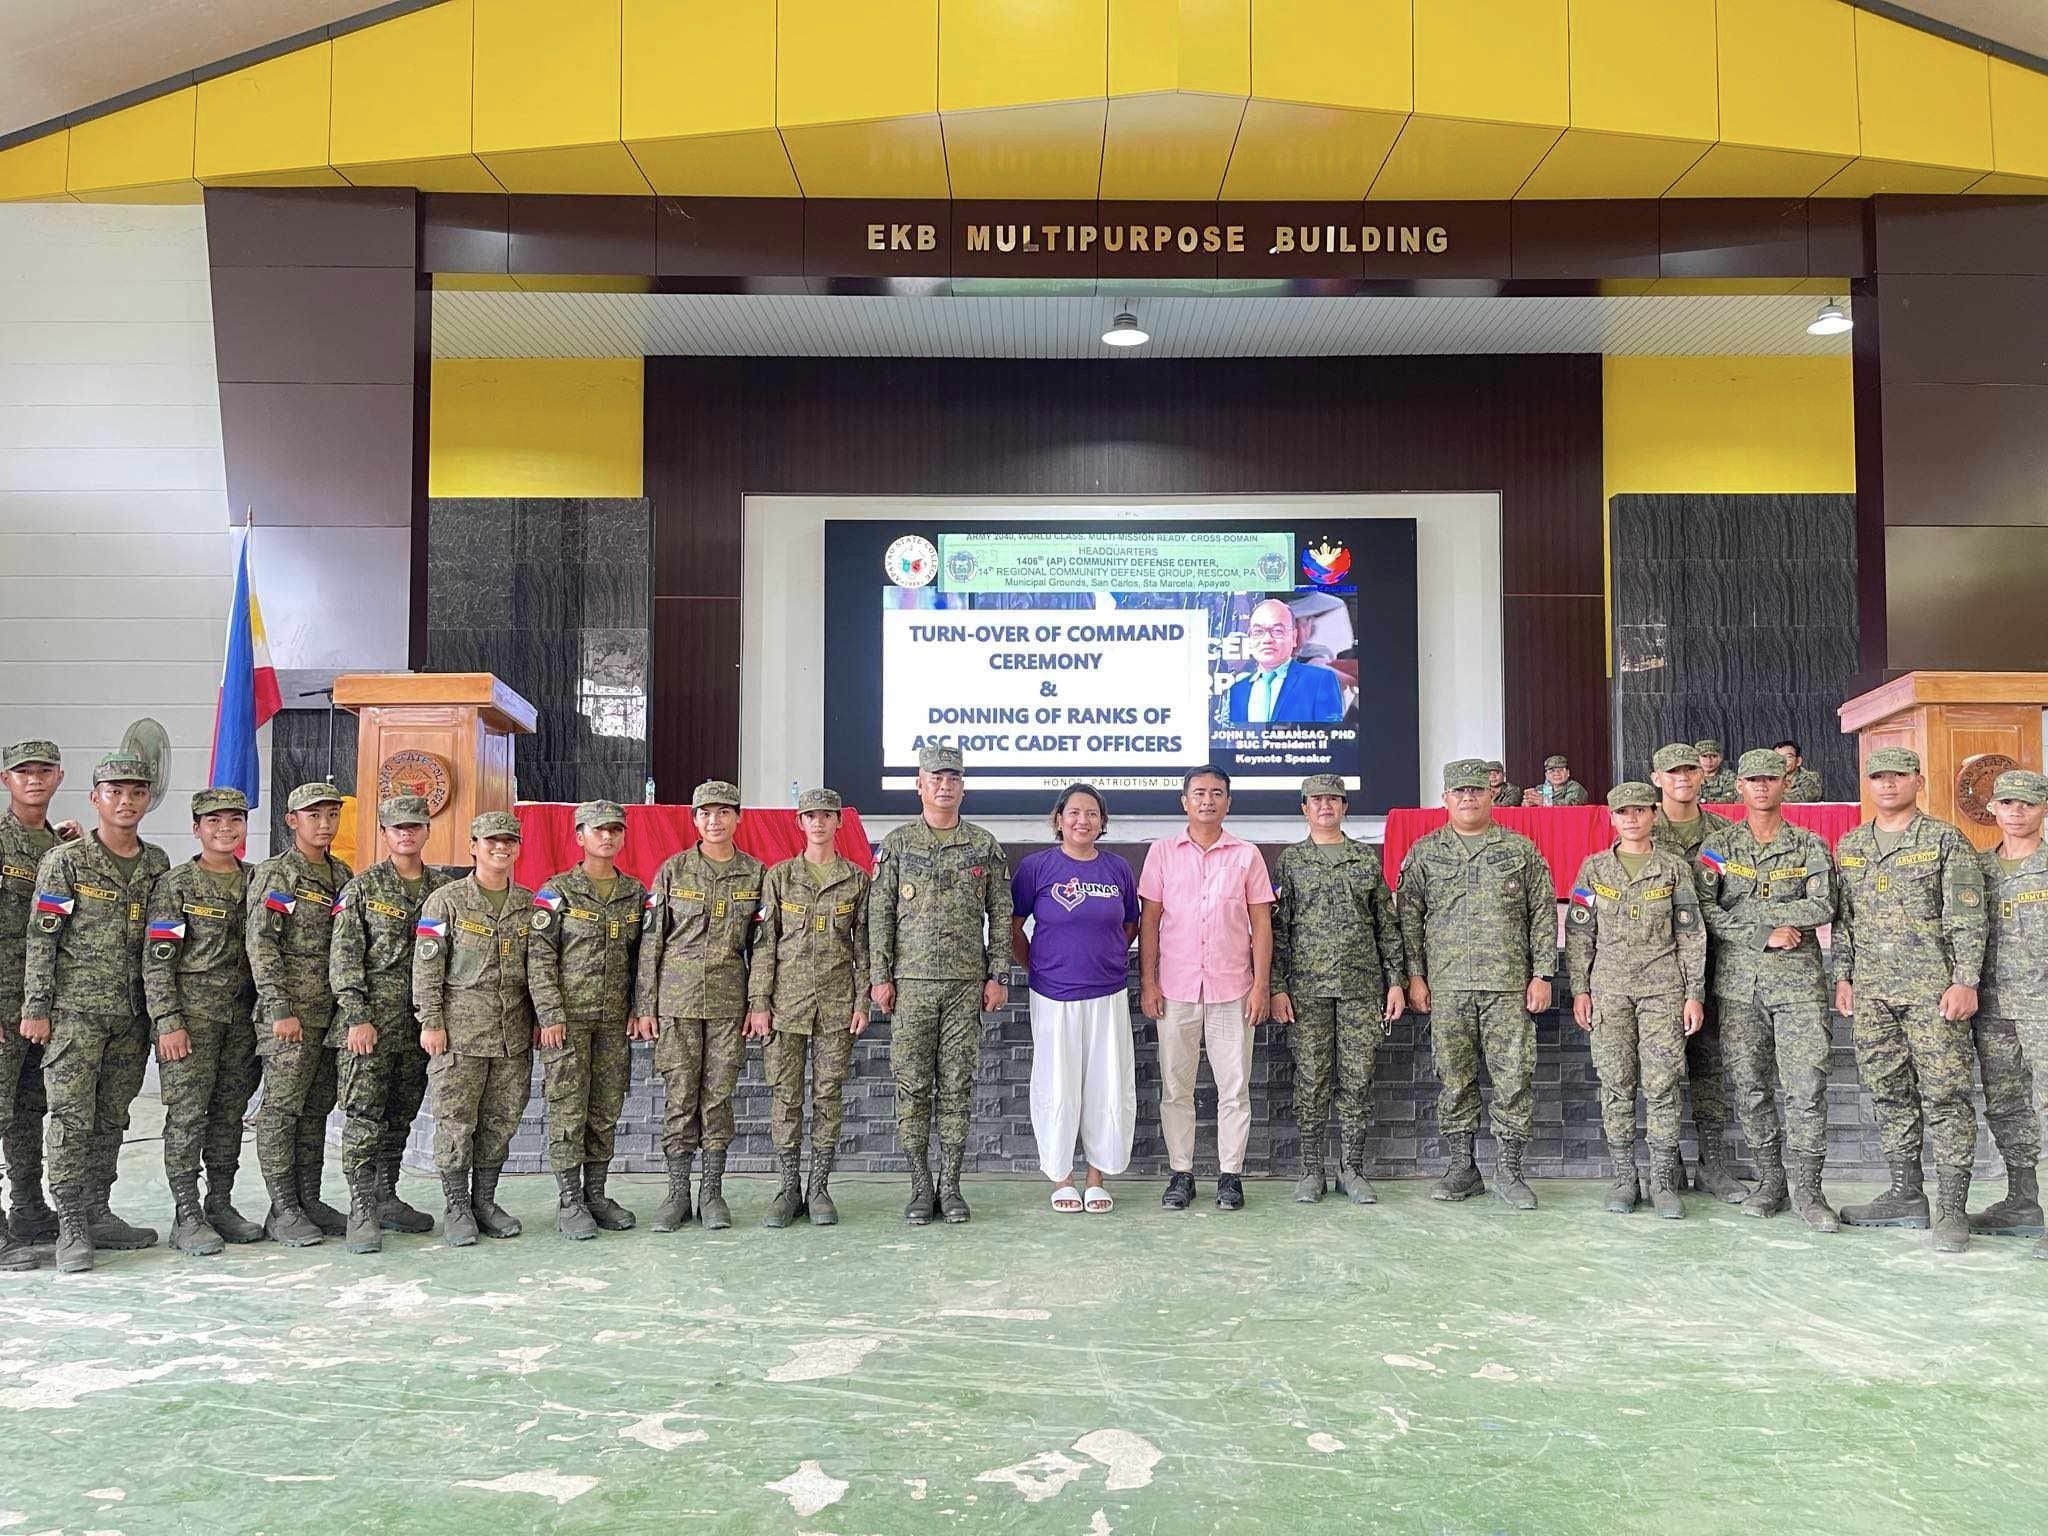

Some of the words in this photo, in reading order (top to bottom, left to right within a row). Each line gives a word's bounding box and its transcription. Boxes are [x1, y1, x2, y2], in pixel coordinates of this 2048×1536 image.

[867, 224, 937, 251] EKB
[966, 225, 1245, 252] MULTIPURPOSE
[1276, 226, 1448, 253] BUILDING
[1078, 547, 1159, 557] HEADQUARTERS
[1046, 557, 1067, 568] (AP)
[1069, 557, 1129, 567] COMMUNITY
[1130, 558, 1175, 567] DEFENSE
[1177, 559, 1219, 568] CENTER,
[996, 567, 1047, 577] REGIONAL
[1049, 568, 1109, 577] COMMUNITY
[1110, 568, 1156, 578] DEFENSE
[1243, 569, 1257, 577] PA
[1004, 578, 1047, 589] Municipal
[1049, 578, 1089, 588] Grounds,
[1091, 578, 1110, 588] San
[1143, 580, 1158, 588] Sta
[1198, 580, 1231, 589] Apayao
[909, 625, 1030, 643] TURN-OVER
[1035, 625, 1062, 643] OF
[1067, 624, 1185, 642] COMMAND
[989, 653, 1103, 670] CEREMONY
[1039, 681, 1058, 697] &
[928, 707, 1029, 725] DONNING
[1035, 707, 1062, 725] OF
[1067, 707, 1138, 725] RANKS
[1143, 707, 1171, 725] OF
[1210, 730, 1244, 741] JOHN
[1330, 730, 1356, 740] PHD
[911, 735, 952, 752] ASC
[957, 735, 1009, 752] ROTC
[1014, 735, 1081, 752] CADET
[1086, 735, 1182, 753] OFFICERS
[1235, 740, 1261, 750] SUC
[1262, 740, 1317, 750] President
[1235, 754, 1282, 766] Keynote
[1284, 754, 1333, 766] Speaker
[1075, 882, 1119, 897] LUNAS
